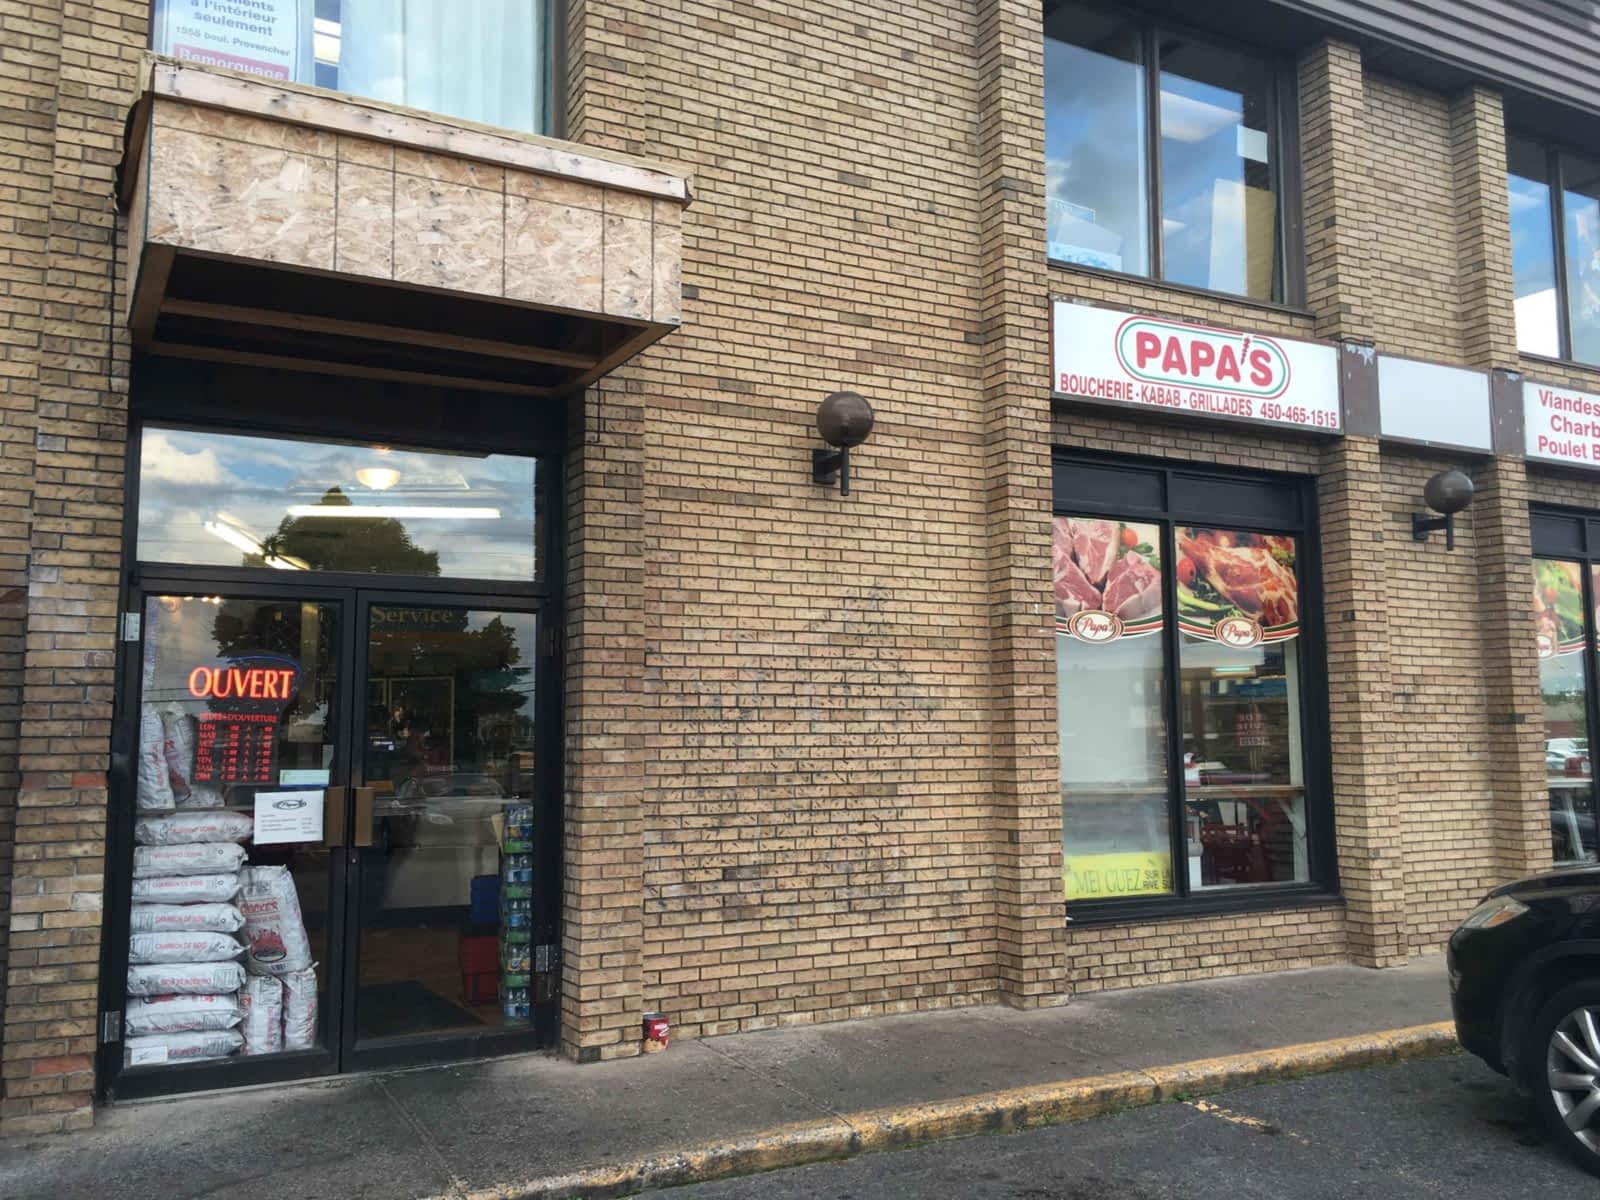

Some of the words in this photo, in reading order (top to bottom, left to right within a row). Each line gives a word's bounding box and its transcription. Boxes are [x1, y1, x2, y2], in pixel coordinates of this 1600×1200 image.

[194, 11, 273, 36] seulement
[233, 37, 290, 56] Provencher
[1135, 331, 1274, 387] PAPA'S
[1060, 373, 1134, 401] BOUCHERIE
[1140, 386, 1181, 409] KABAB
[1189, 391, 1254, 417] GRILLADES
[1259, 402, 1338, 428] 450-465-1515
[1538, 389, 1600, 417] Viandes
[1538, 435, 1588, 459] Poulet
[370, 605, 453, 623] Service
[189, 667, 294, 699] OUVERT
